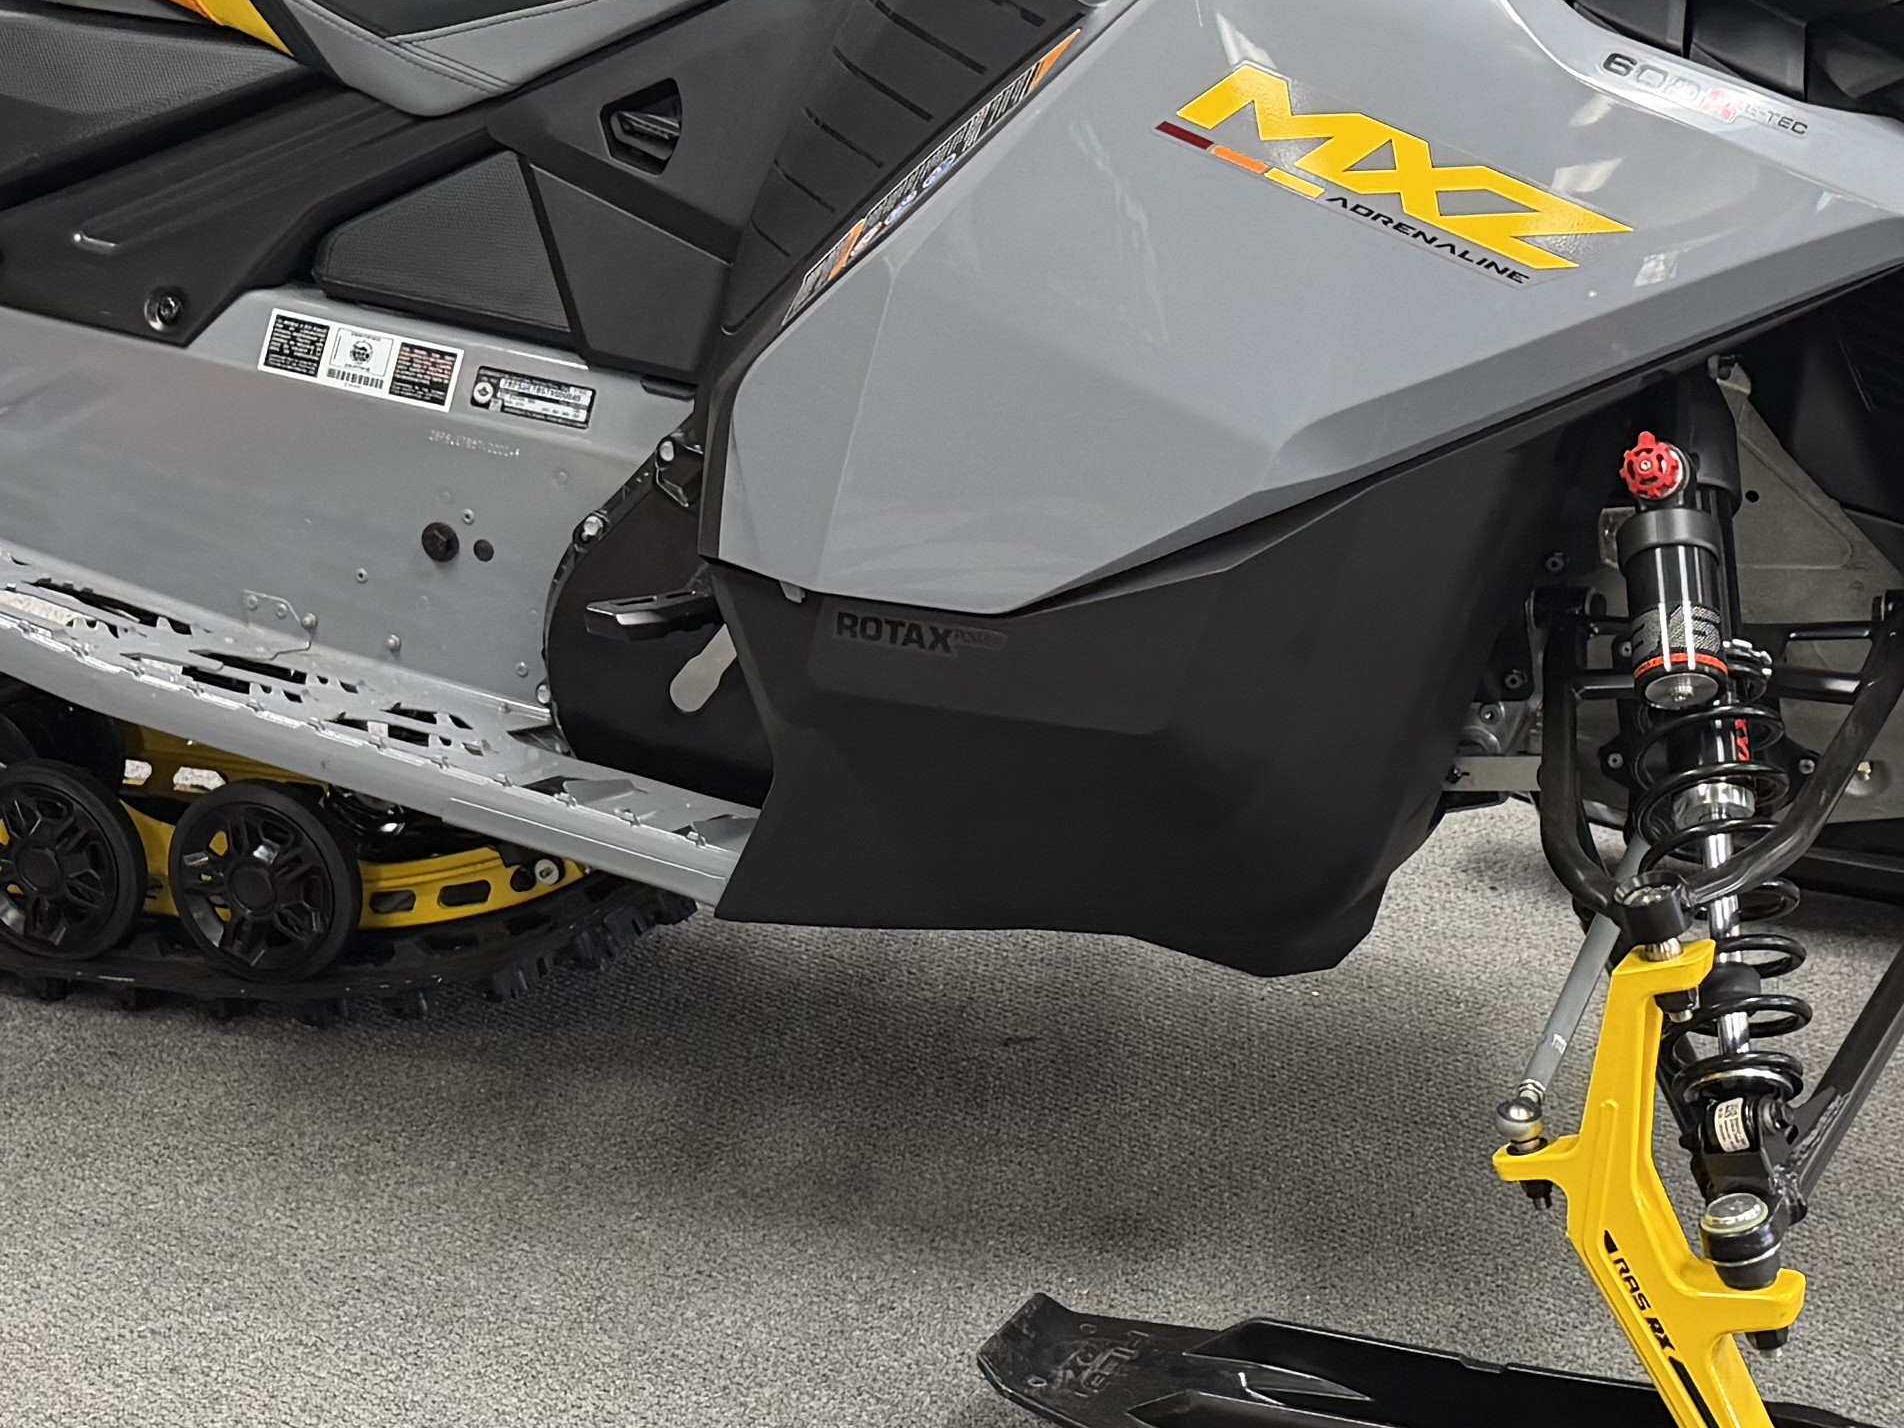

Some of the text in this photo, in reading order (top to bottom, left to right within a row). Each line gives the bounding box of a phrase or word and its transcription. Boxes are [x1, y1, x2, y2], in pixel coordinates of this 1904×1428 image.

[1175, 64, 1634, 270] MXZ
[1326, 196, 1531, 285] ADRENALINE
[836, 611, 952, 654] ROTAX
[1612, 1257, 1676, 1351] RAS RX
